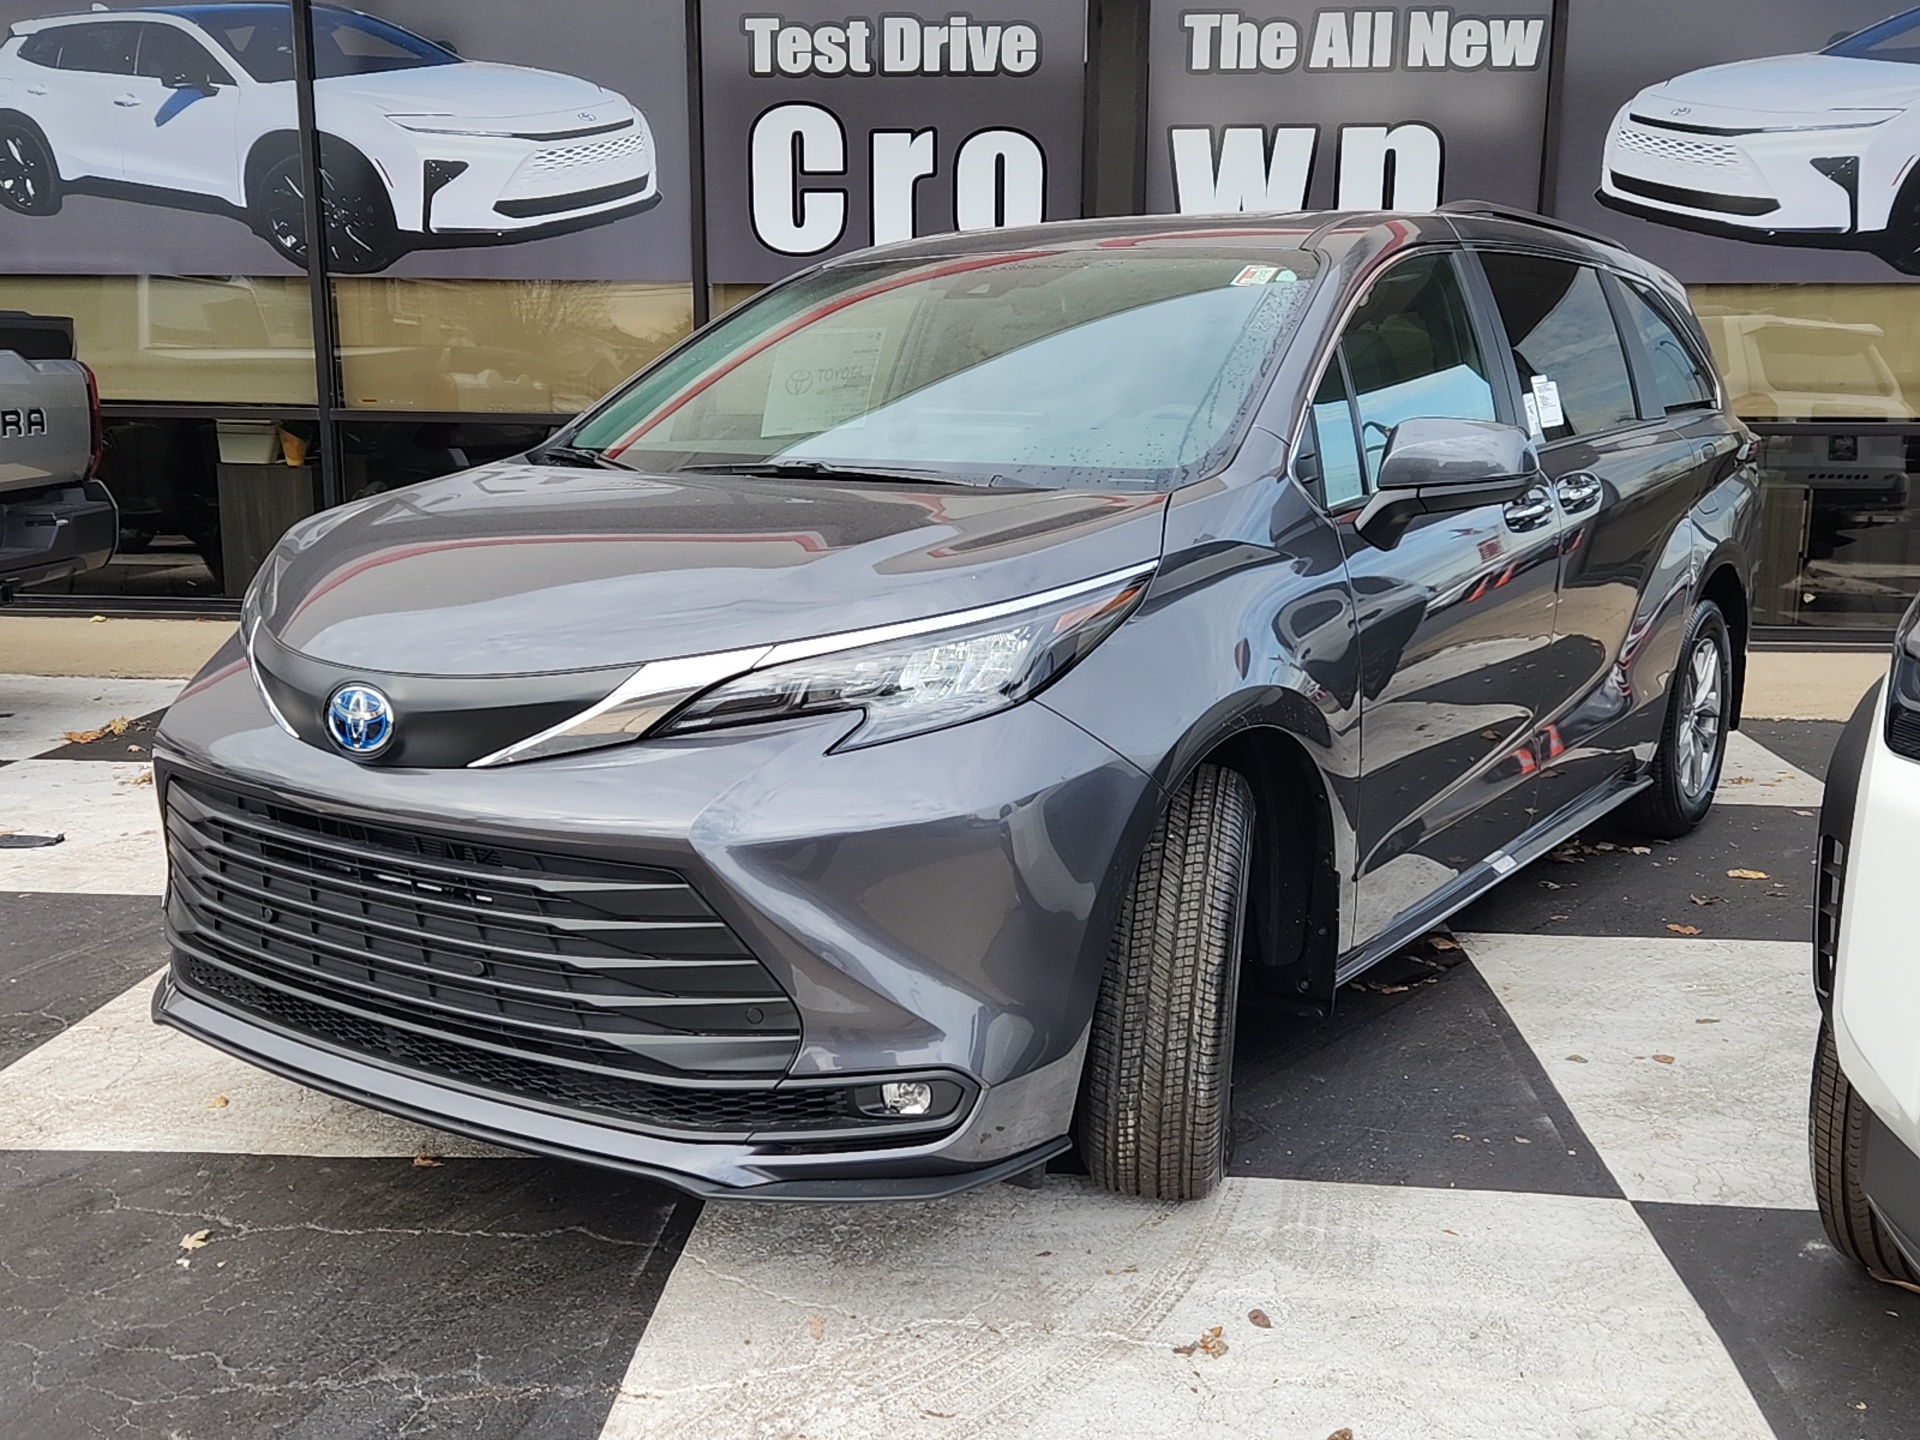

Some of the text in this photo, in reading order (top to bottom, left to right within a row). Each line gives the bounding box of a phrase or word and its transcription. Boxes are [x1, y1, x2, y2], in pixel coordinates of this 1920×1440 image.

[744, 16, 1037, 73] Test Drive
[1184, 11, 1544, 70] The All New
